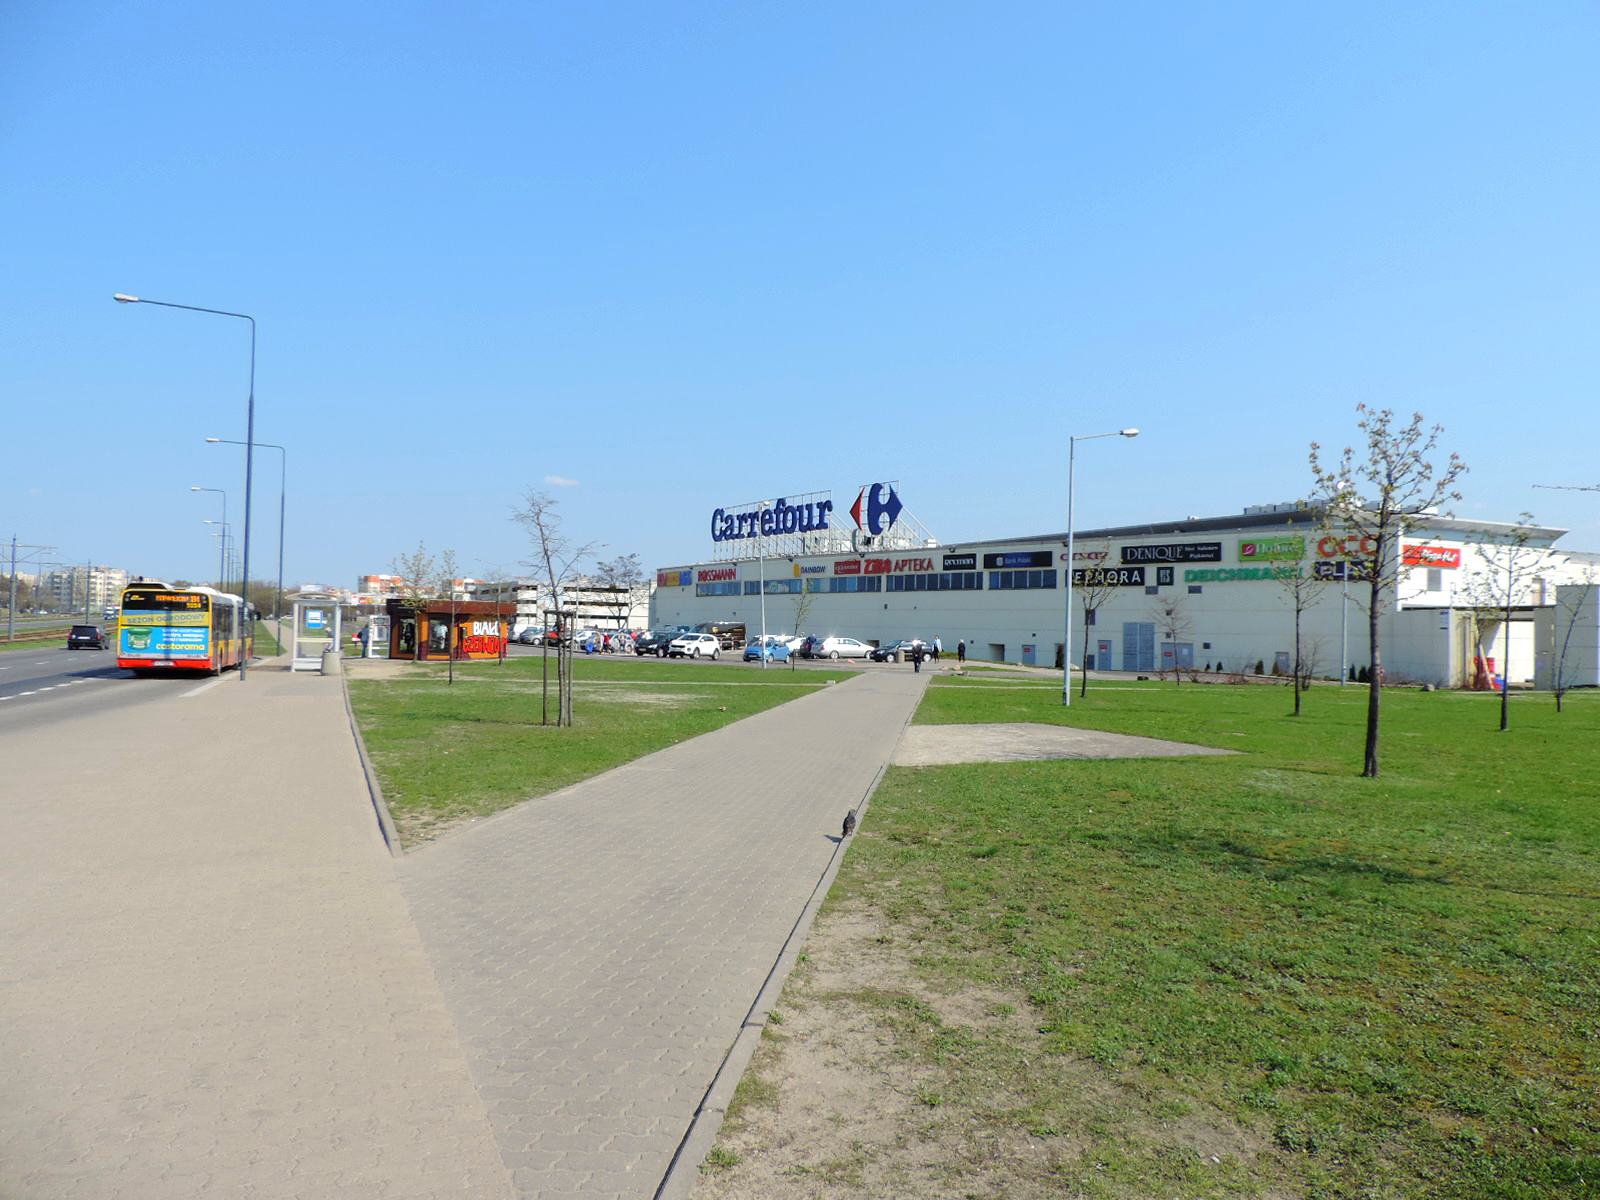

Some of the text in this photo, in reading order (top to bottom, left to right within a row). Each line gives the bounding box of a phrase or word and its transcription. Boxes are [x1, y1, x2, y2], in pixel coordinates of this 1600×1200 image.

[711, 498, 833, 542] Carrefour
[1127, 546, 1183, 561] DENIQUE
[800, 565, 826, 574] RAINBOW
[893, 558, 935, 573] APTEKA
[697, 567, 737, 582] ROSSMANN
[1072, 570, 1142, 585] EPHORA
